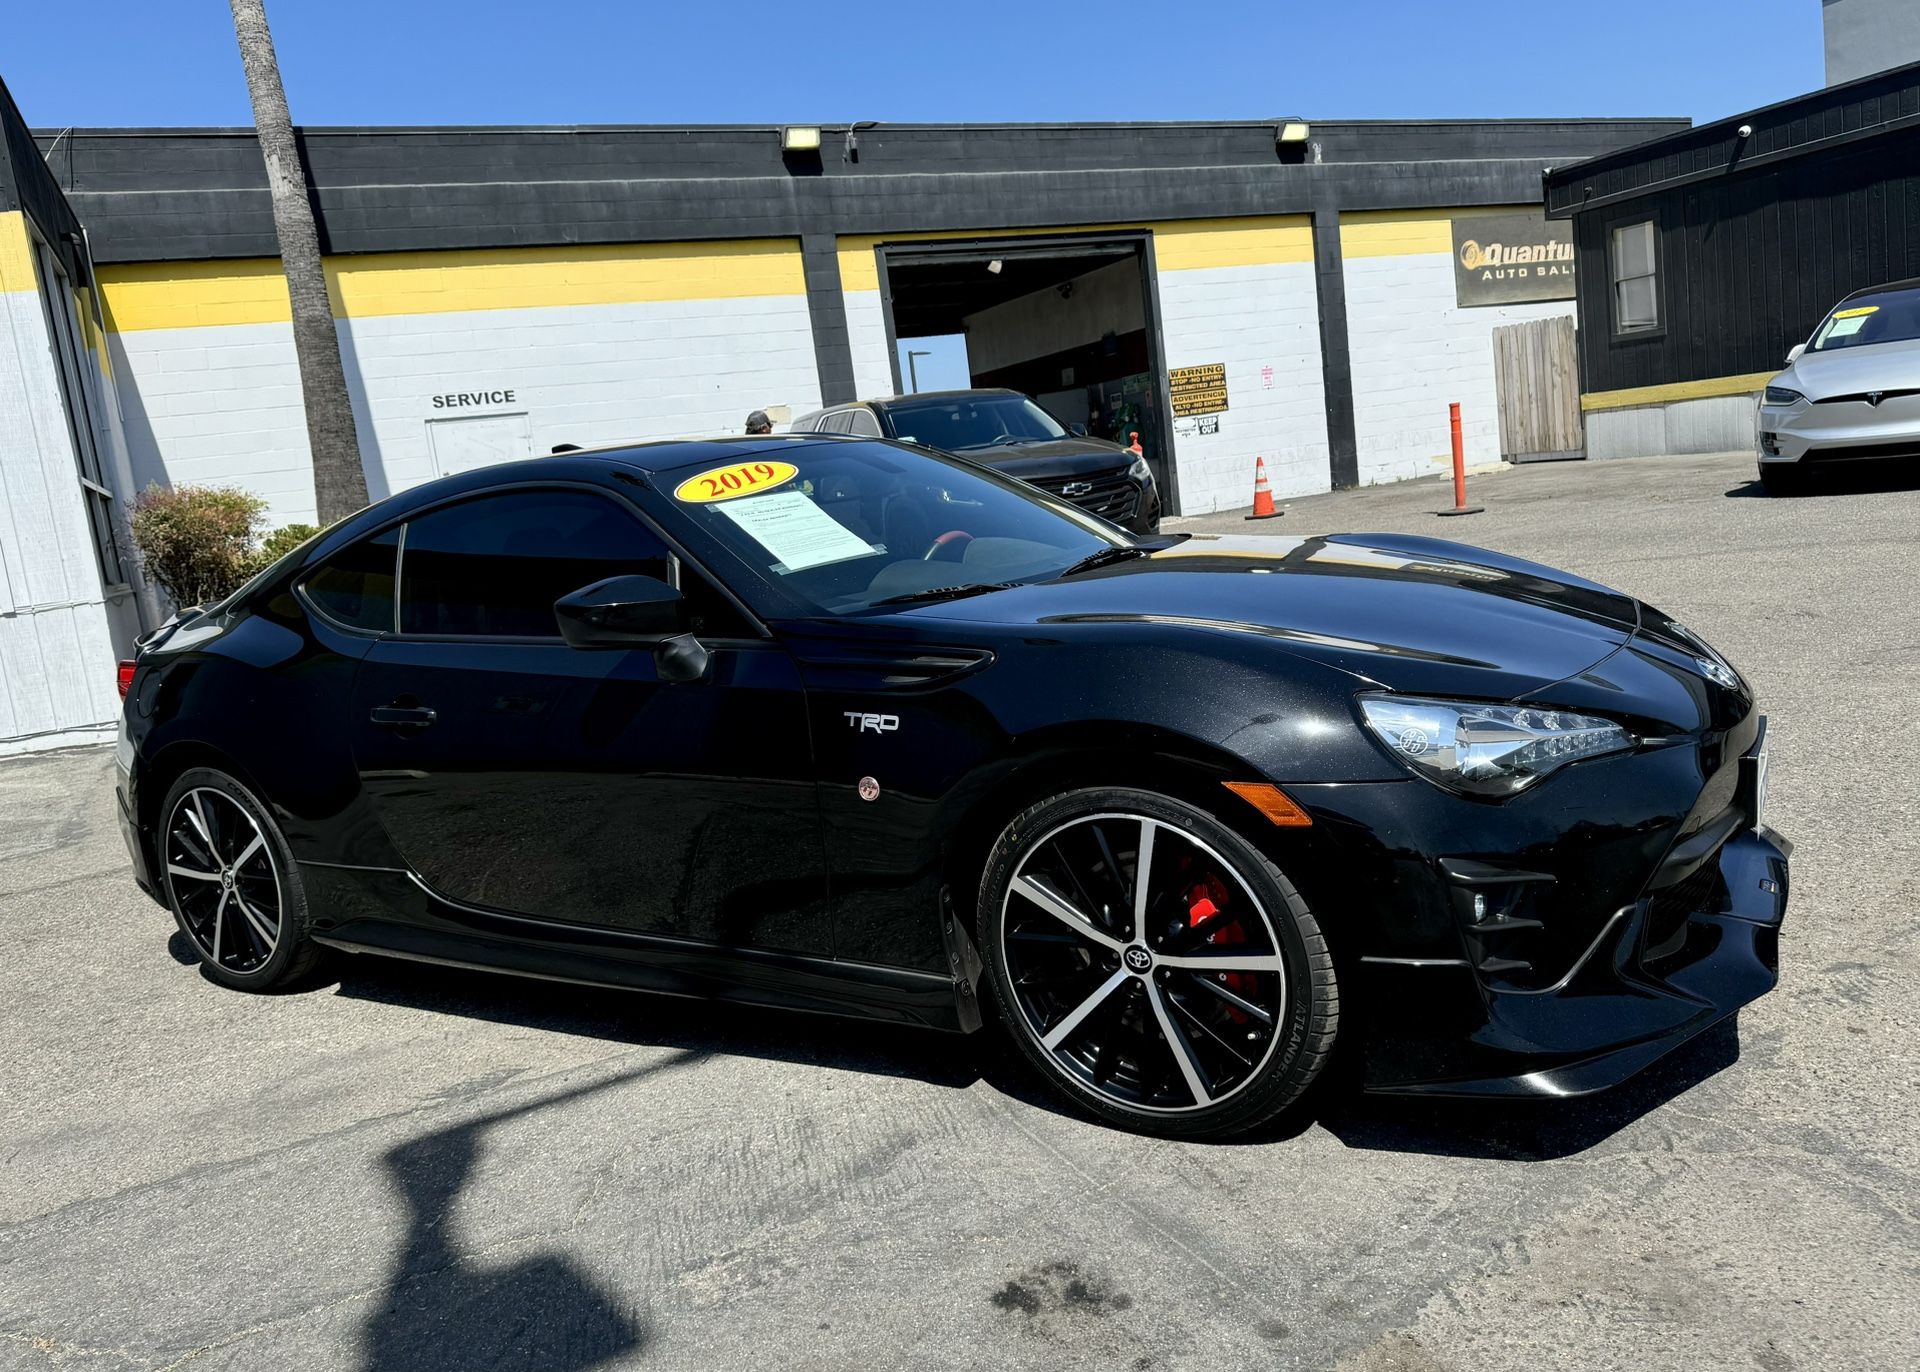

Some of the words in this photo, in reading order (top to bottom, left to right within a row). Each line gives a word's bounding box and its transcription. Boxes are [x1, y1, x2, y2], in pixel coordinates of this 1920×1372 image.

[1483, 240, 1575, 267] Quantu
[1482, 268, 1528, 280] AUTO
[1537, 265, 1575, 276] SAL
[1170, 366, 1223, 378] WARNING
[1171, 383, 1208, 391] RESTRICTED
[432, 390, 516, 408] SERVICE
[1173, 391, 1225, 403] ADVERTENCIA
[1199, 417, 1217, 426] KEEP
[1201, 425, 1216, 433] OUT
[700, 463, 775, 498] 2019
[843, 711, 900, 734] TRD
[1271, 998, 1307, 1083] ATLANDER
